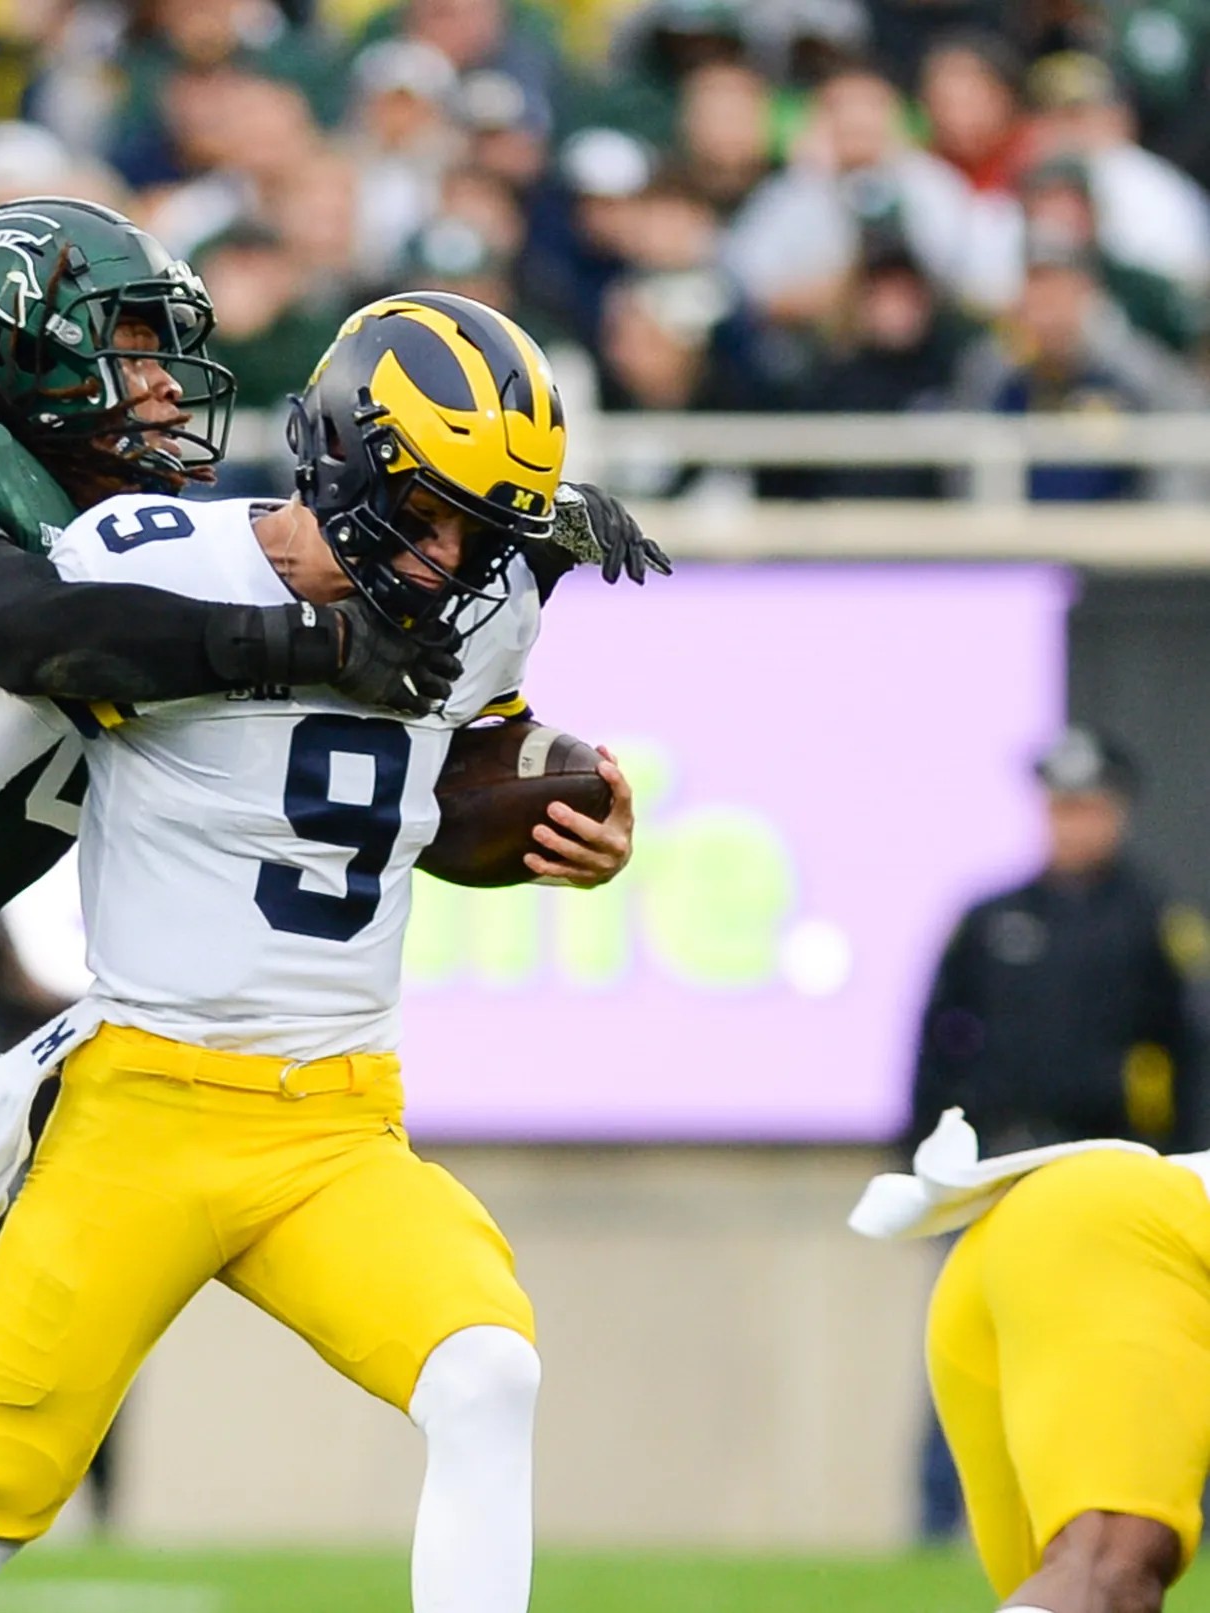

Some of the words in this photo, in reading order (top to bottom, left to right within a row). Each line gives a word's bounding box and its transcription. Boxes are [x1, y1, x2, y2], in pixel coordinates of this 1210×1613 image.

[511, 489, 535, 511] M
[96, 505, 195, 554] 9
[254, 713, 412, 942] 9
